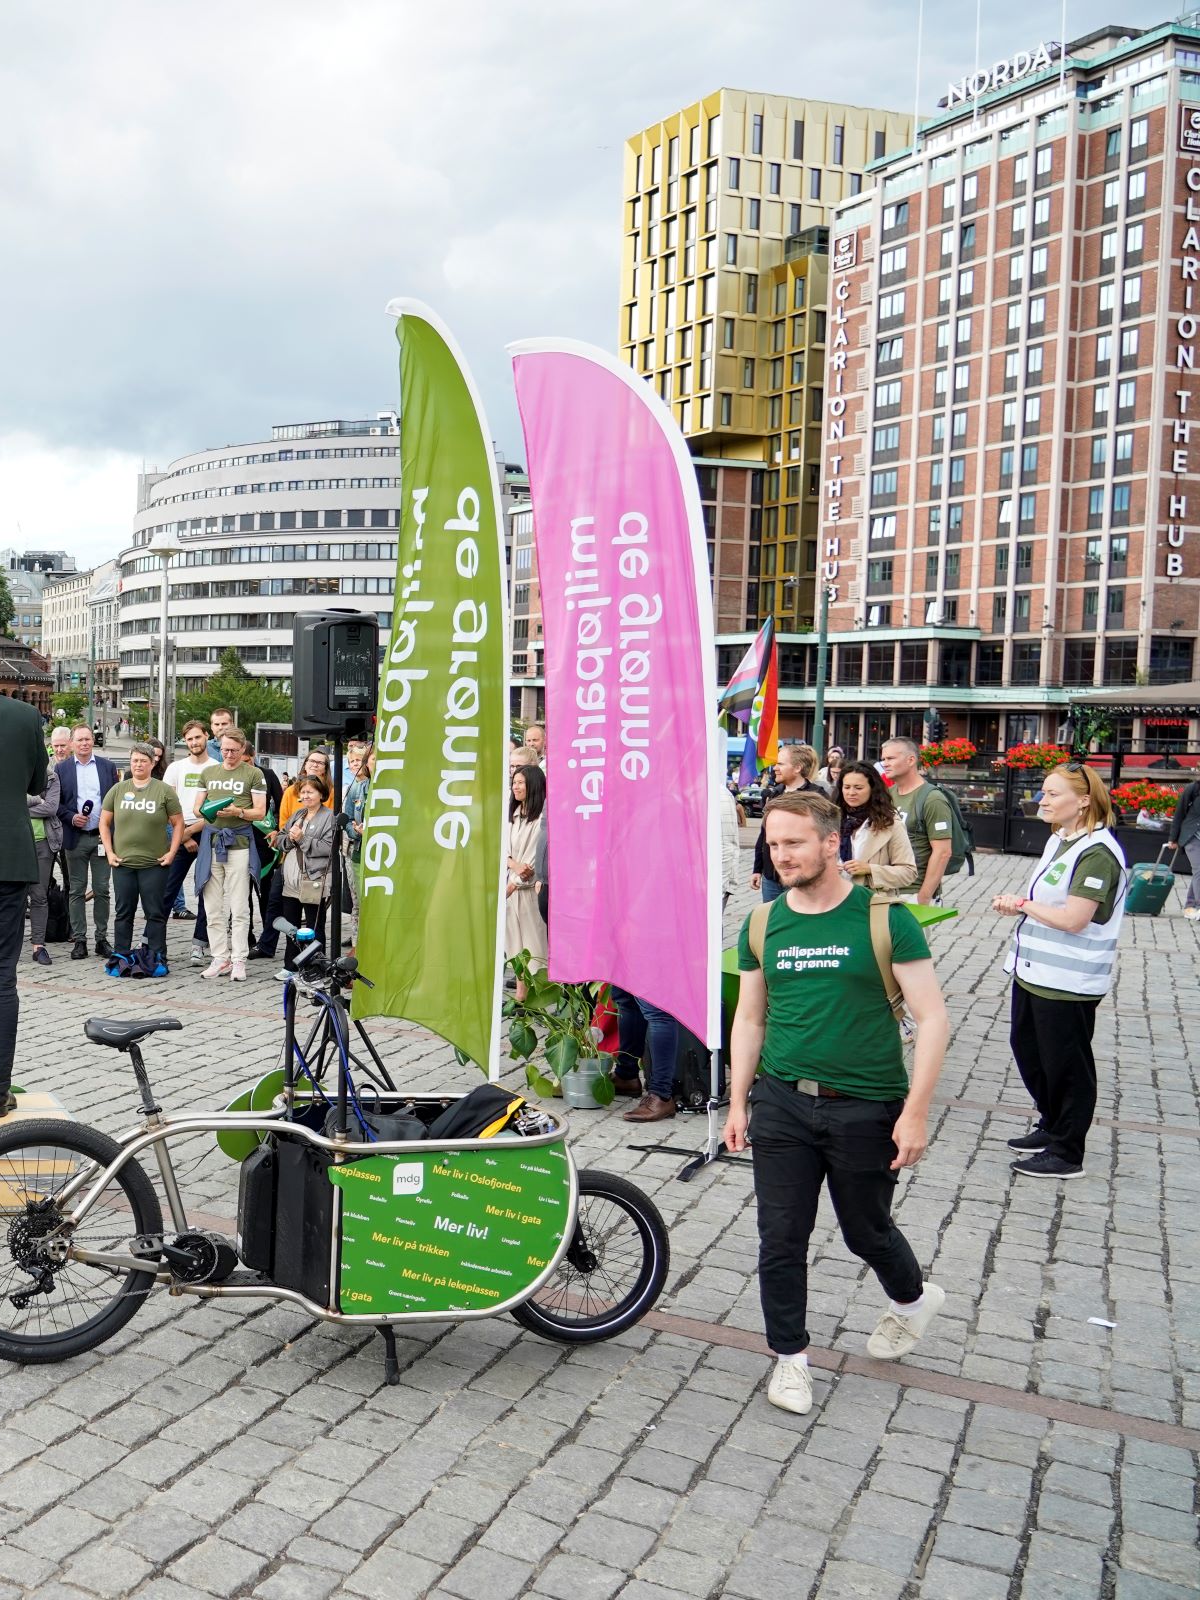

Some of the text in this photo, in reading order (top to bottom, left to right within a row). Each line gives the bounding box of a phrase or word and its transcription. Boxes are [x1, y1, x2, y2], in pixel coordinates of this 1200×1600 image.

[946, 41, 1052, 107] NORDA
[830, 281, 850, 440] CLARION
[1166, 167, 1200, 577] CLARION THE HUB
[828, 455, 842, 520] THE
[208, 778, 244, 794] mdg
[120, 798, 156, 814] mdg
[777, 945, 850, 958] miljøpartiet
[776, 960, 840, 972] de grønne
[332, 1166, 381, 1182] keplassen
[396, 1174, 420, 1186] mdg
[432, 1164, 522, 1192] Mer liv i Oslofjorden
[486, 1204, 504, 1217] Mer
[506, 1209, 516, 1220] liv
[522, 1214, 542, 1225] gata
[434, 1216, 488, 1240] Mer liv!
[372, 1232, 450, 1258] Mer liv på trikken
[527, 1256, 544, 1267] Mer
[402, 1268, 500, 1298] Mer liv på lekeplassen
[351, 1292, 373, 1302] gata
